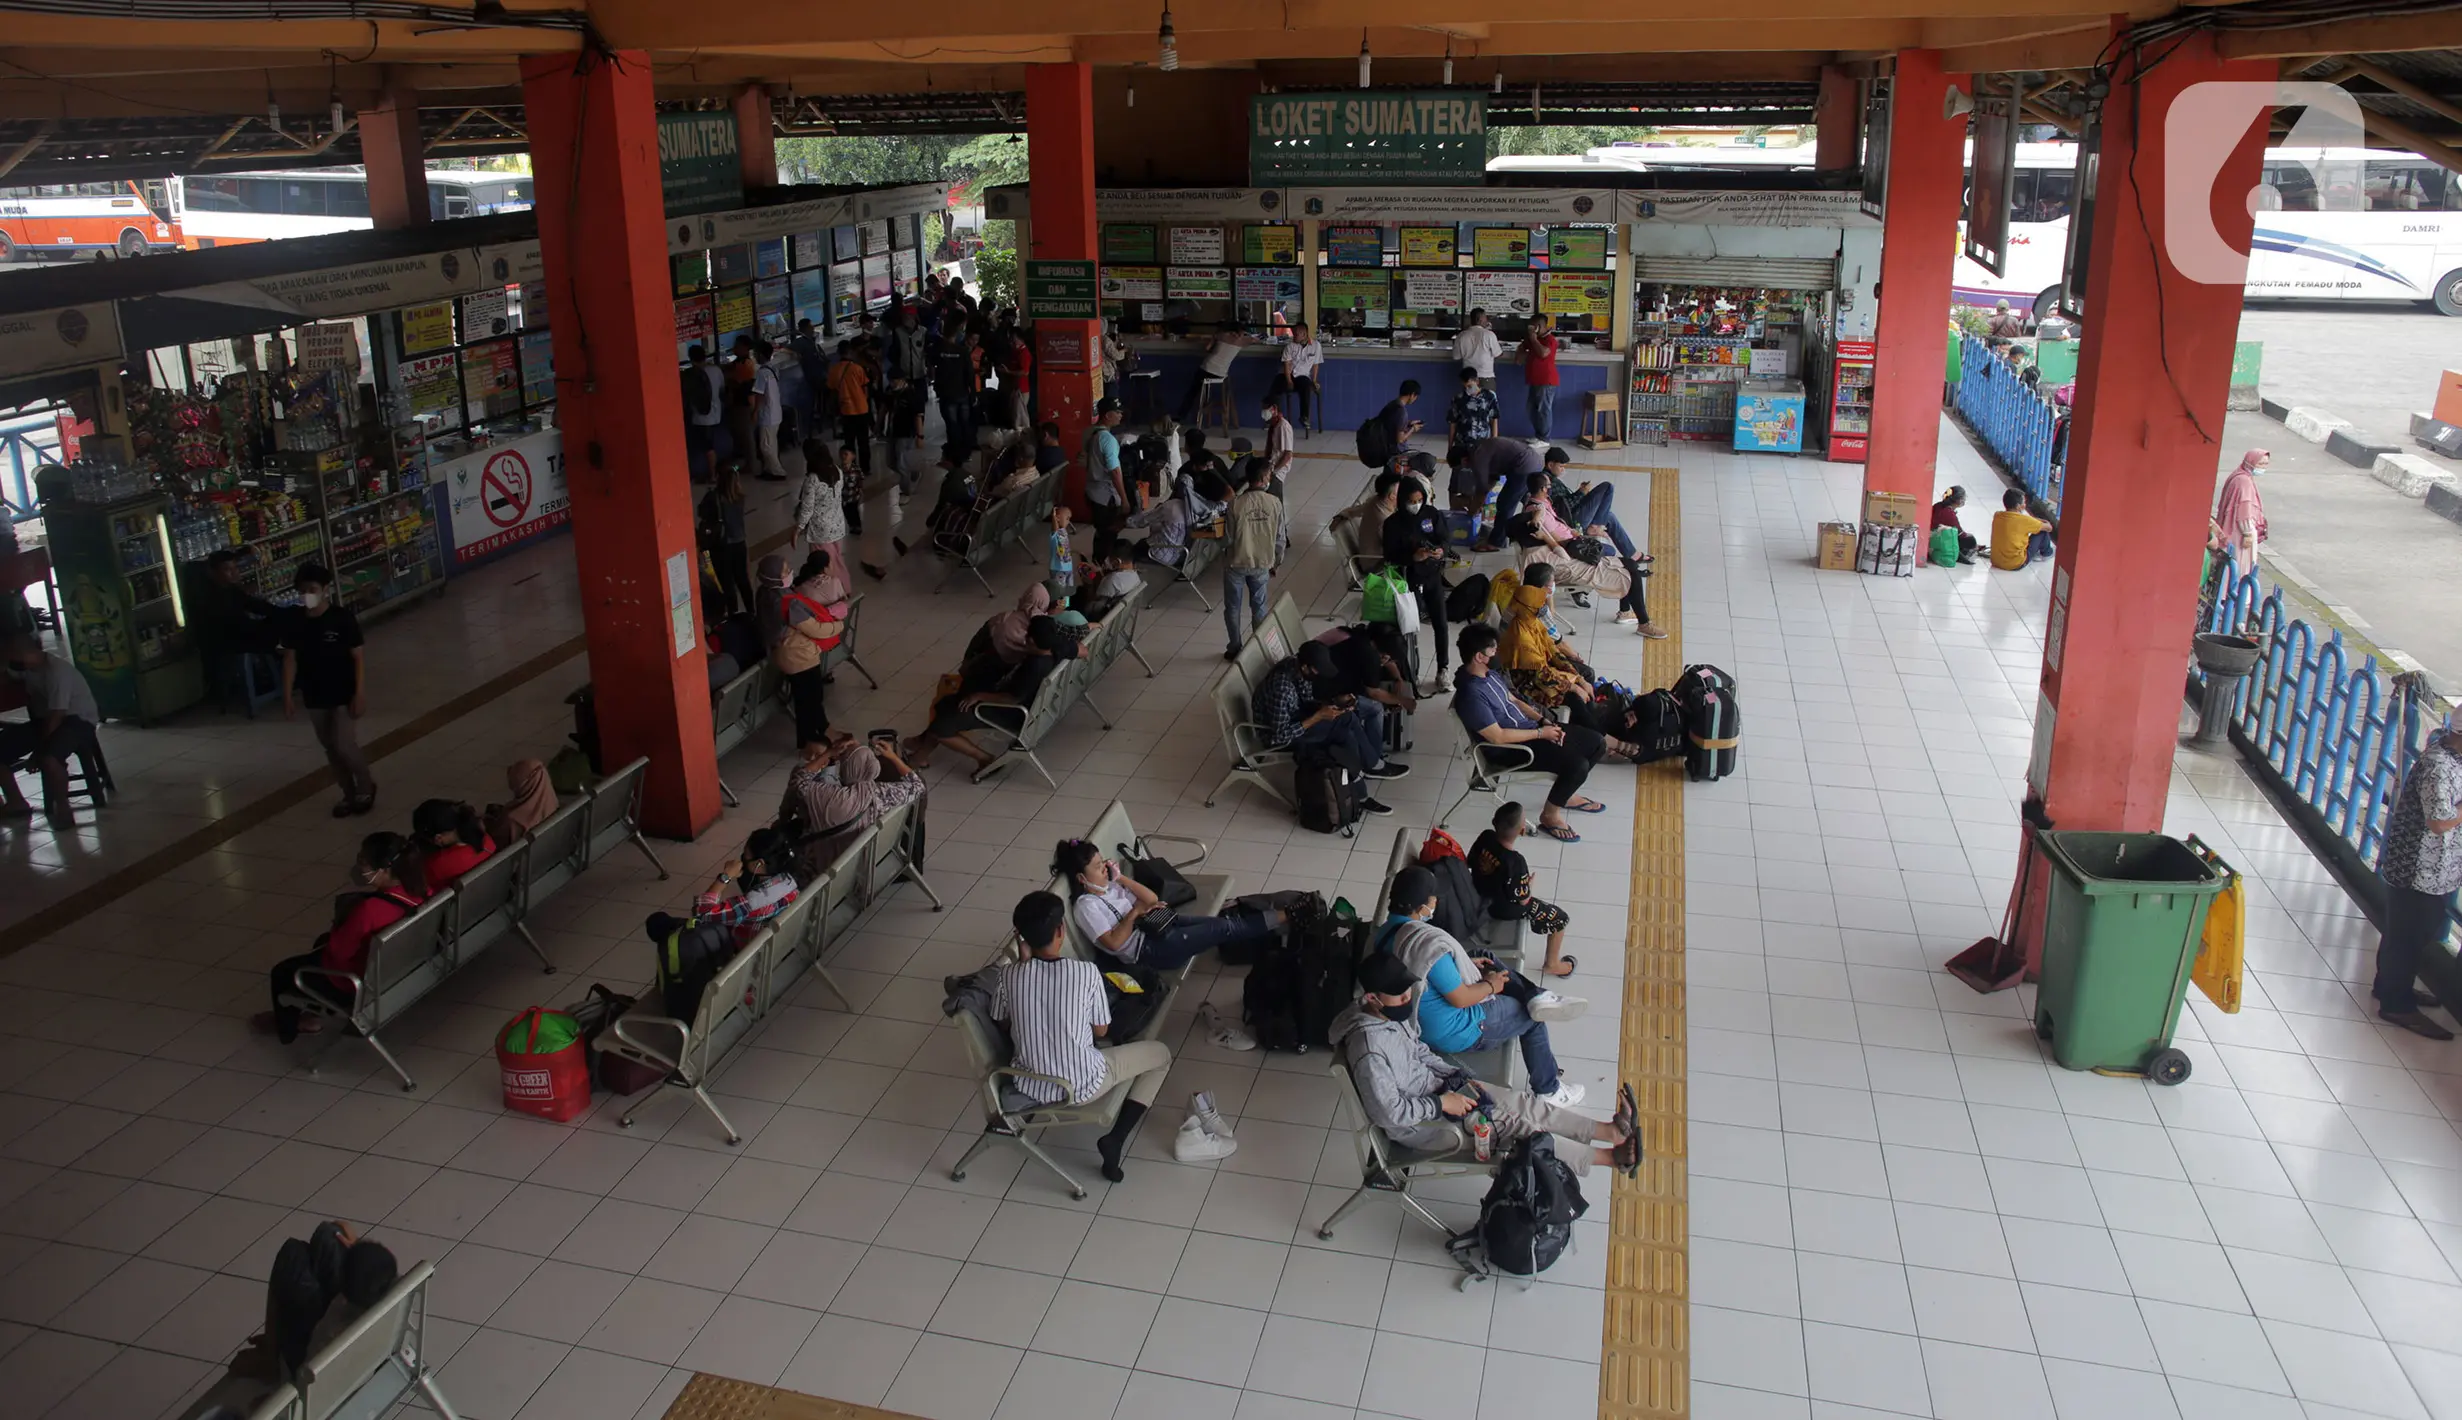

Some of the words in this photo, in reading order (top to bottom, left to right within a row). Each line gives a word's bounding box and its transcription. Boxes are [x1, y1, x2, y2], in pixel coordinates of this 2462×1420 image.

[1255, 101, 1337, 137] LOKET
[1344, 99, 1484, 136] SUMATERA
[657, 118, 737, 163] SUMATERA
[1106, 191, 1129, 200] ANDA
[1147, 191, 1174, 200] SESUAI
[1176, 191, 1209, 200] DENGAN
[1724, 195, 1749, 203] ANDA
[1751, 194, 1777, 202] SEHAT
[1779, 194, 1797, 202] DAN
[1799, 195, 1827, 203] PRIMA
[4, 206, 28, 215] MUDA
[2402, 224, 2440, 233] DAMRI
[280, 275, 328, 290] MAKANAN
[329, 271, 348, 283] DAN
[349, 264, 394, 280] MINUMAN
[1037, 265, 1086, 277] INFORMASI
[356, 281, 391, 296] DIKENAL
[1048, 284, 1067, 296] DAN
[2246, 280, 2291, 288] NGKUTAN
[2294, 281, 2333, 289] PEMADU
[1031, 301, 1093, 313] PENGADUAN
[414, 354, 454, 372] MPM
[546, 452, 566, 473] TA
[539, 495, 571, 515] TERMIN
[460, 519, 546, 561] TERIMAKASIH
